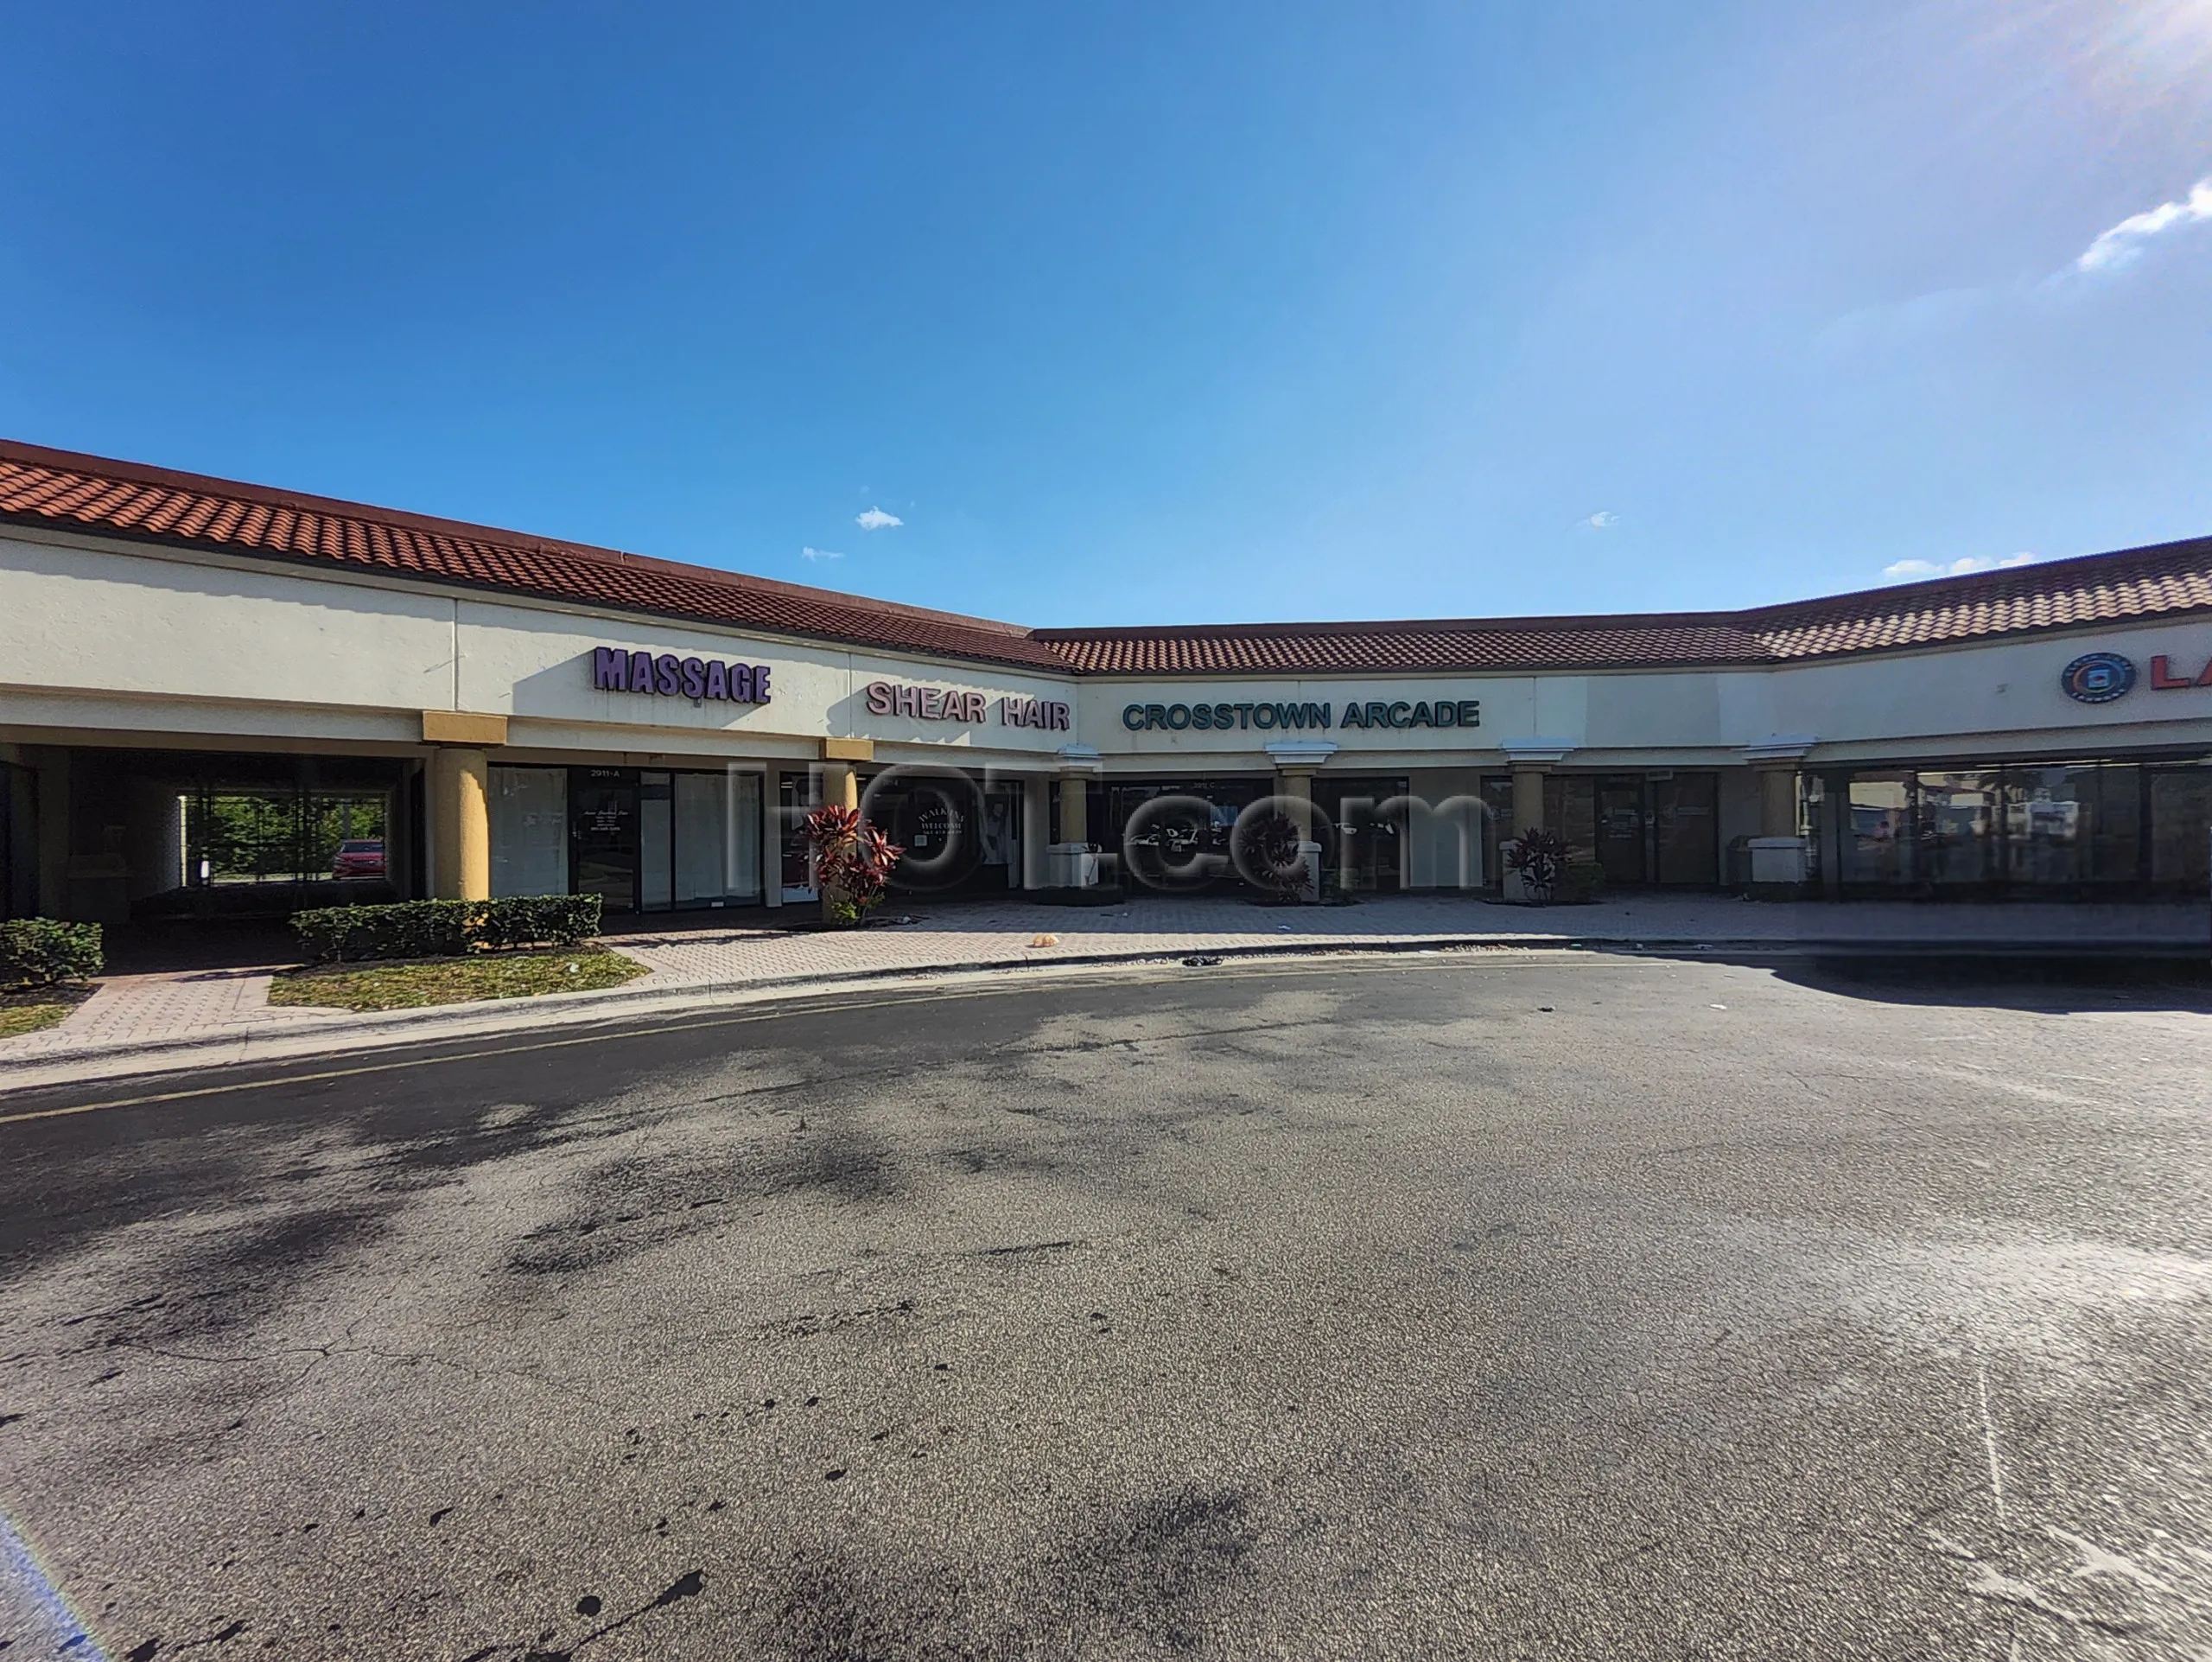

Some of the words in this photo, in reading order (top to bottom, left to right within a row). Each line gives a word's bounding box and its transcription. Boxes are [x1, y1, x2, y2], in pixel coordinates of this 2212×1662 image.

[594, 647, 771, 704] MASSAGE
[867, 681, 986, 724] SHEAR
[1001, 695, 1071, 731] HAIR
[1122, 702, 1332, 731] CROSSTOWN
[1341, 700, 1480, 729] ARCADE
